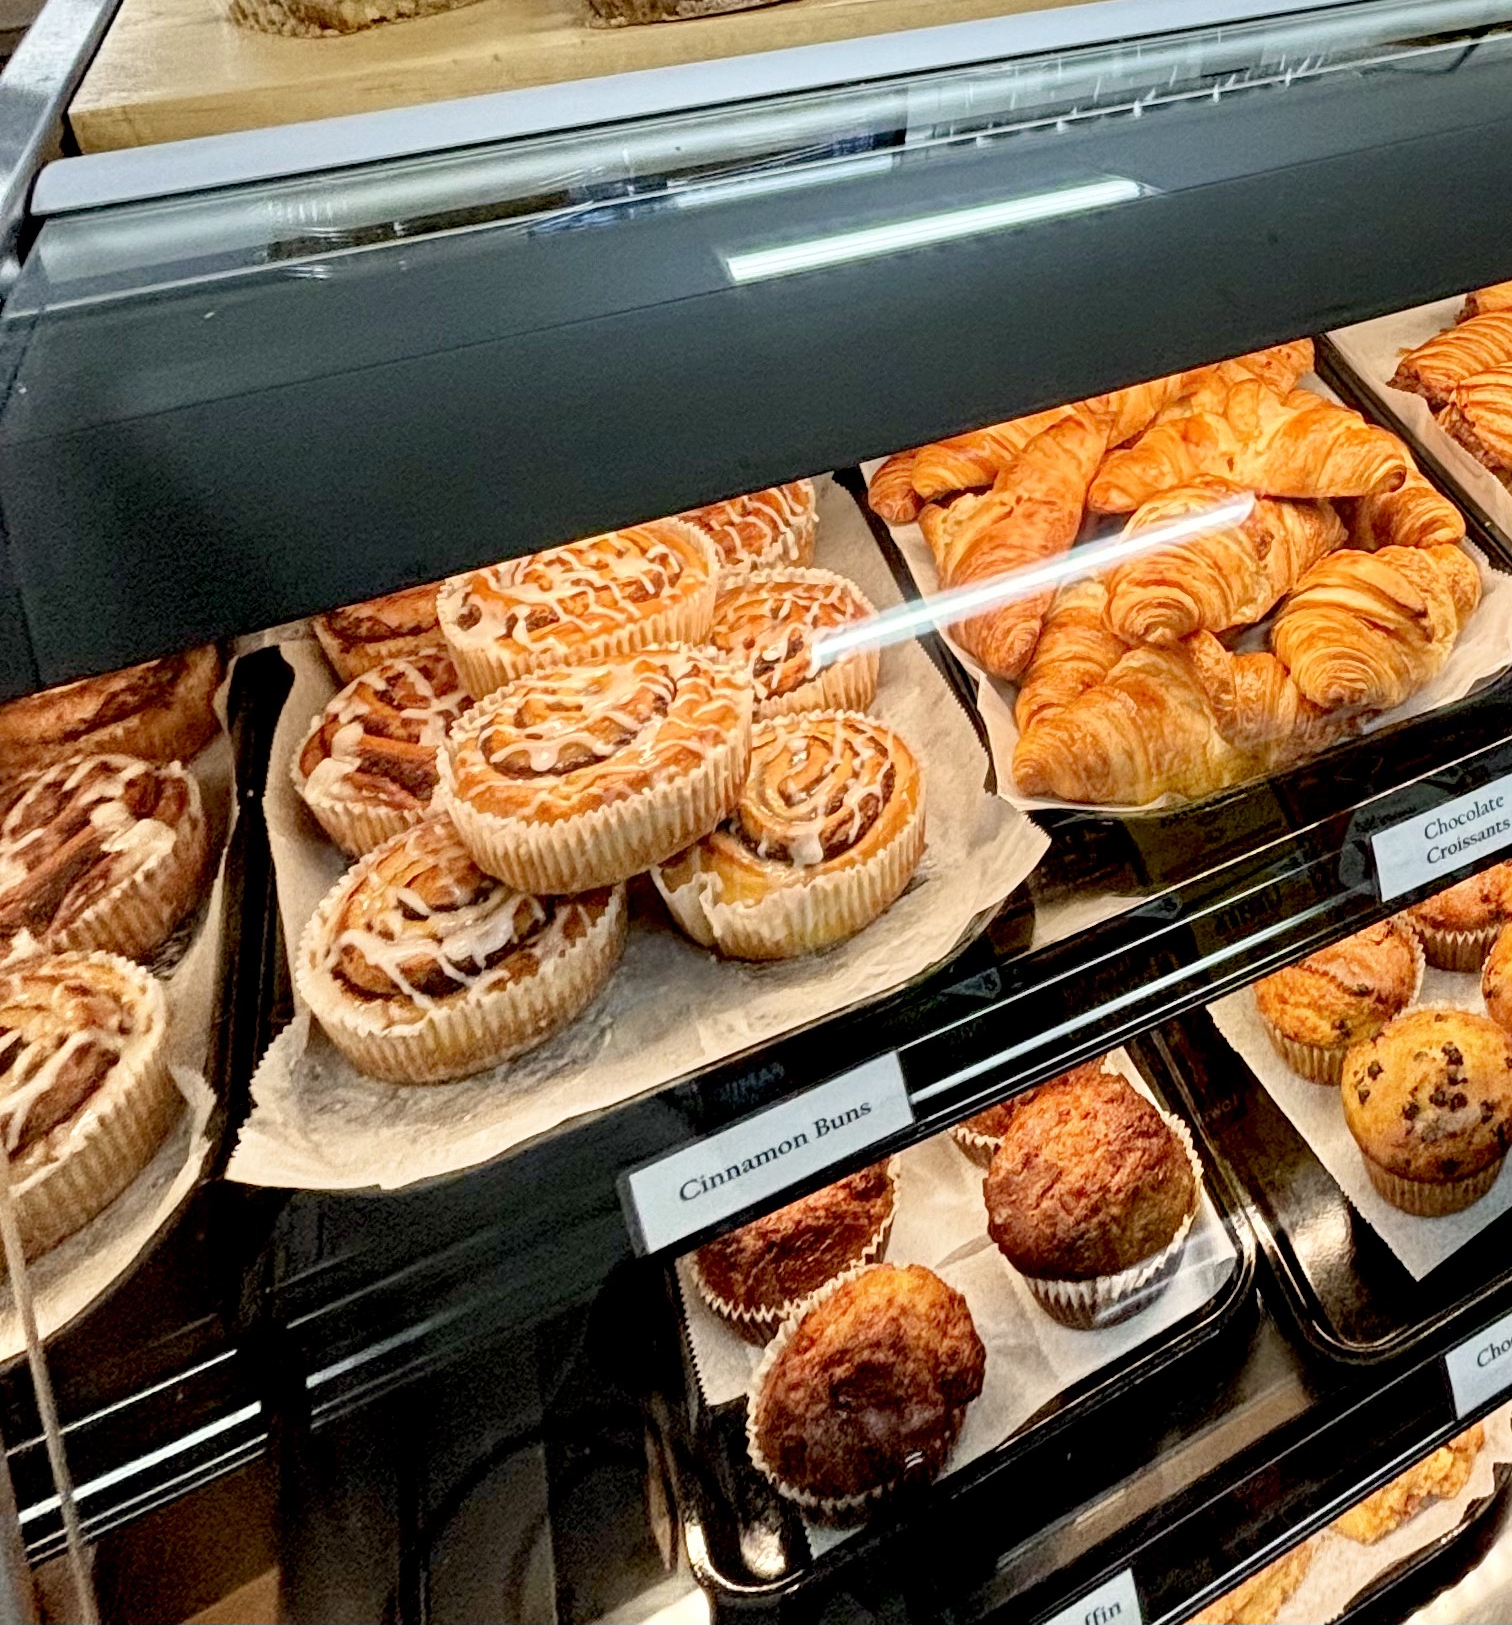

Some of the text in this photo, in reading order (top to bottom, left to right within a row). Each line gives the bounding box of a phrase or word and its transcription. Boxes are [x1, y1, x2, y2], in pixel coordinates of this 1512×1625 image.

[1423, 795, 1505, 841] Chocolate
[1426, 818, 1512, 865] Croissants
[678, 1101, 873, 1202] Cinnamon Buns
